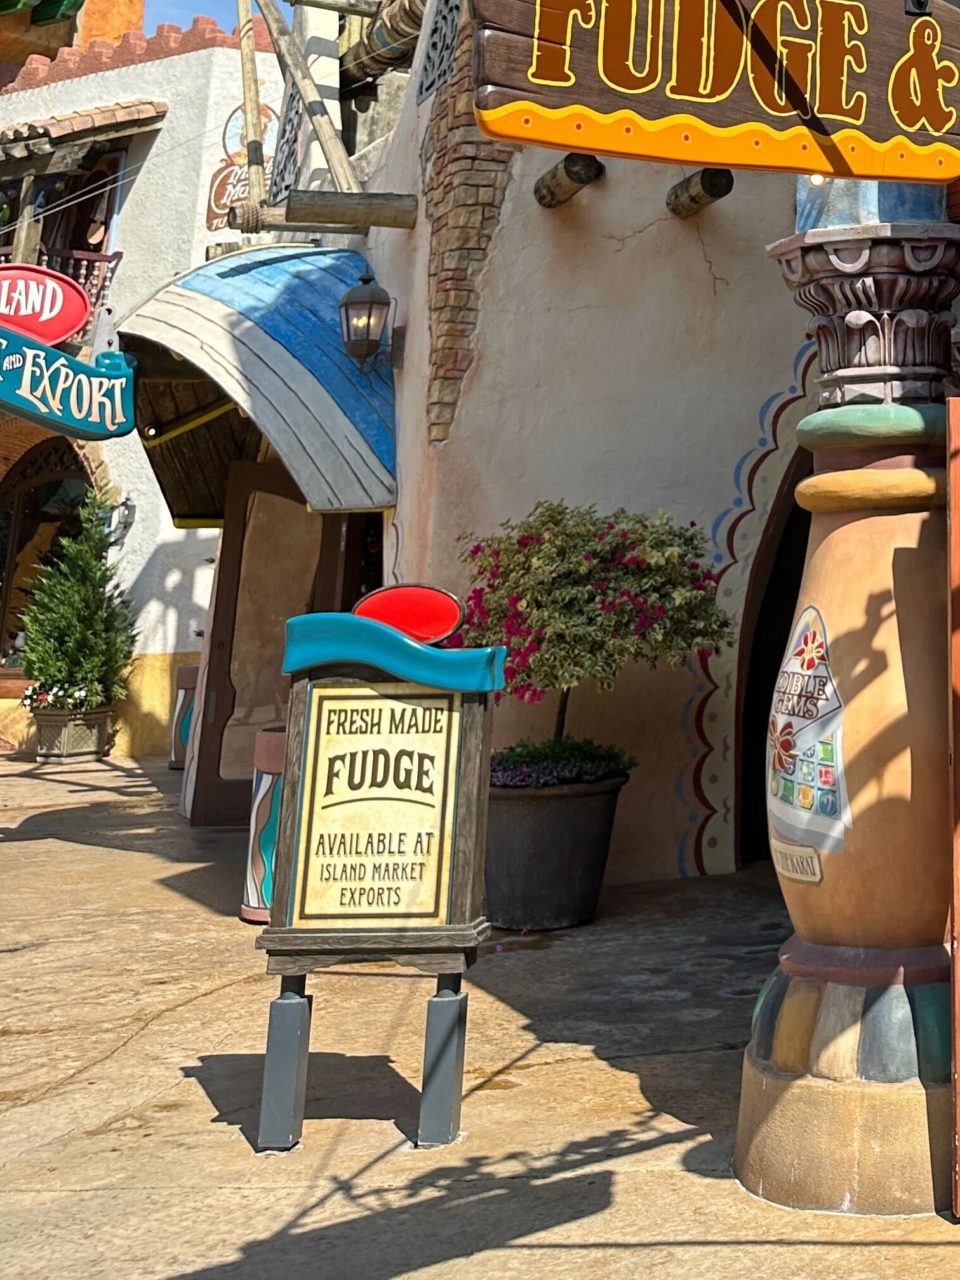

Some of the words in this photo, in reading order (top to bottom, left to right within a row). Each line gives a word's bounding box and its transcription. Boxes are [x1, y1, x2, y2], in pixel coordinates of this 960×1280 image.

[888, 16, 959, 135] &
[0, 278, 64, 322] LAND
[2, 353, 24, 372] AND
[15, 346, 127, 432] EXPORT
[775, 670, 830, 701] EDIBLE
[325, 707, 384, 736] FRESH
[388, 706, 445, 735] MADE
[774, 693, 820, 720] GEMS
[323, 747, 436, 798] FUDGE
[315, 832, 407, 857] AVAILABLE
[413, 832, 435, 857] AT
[319, 863, 366, 883] ISLAND
[371, 862, 426, 882] MARKET
[339, 887, 402, 908] EXPORTS
